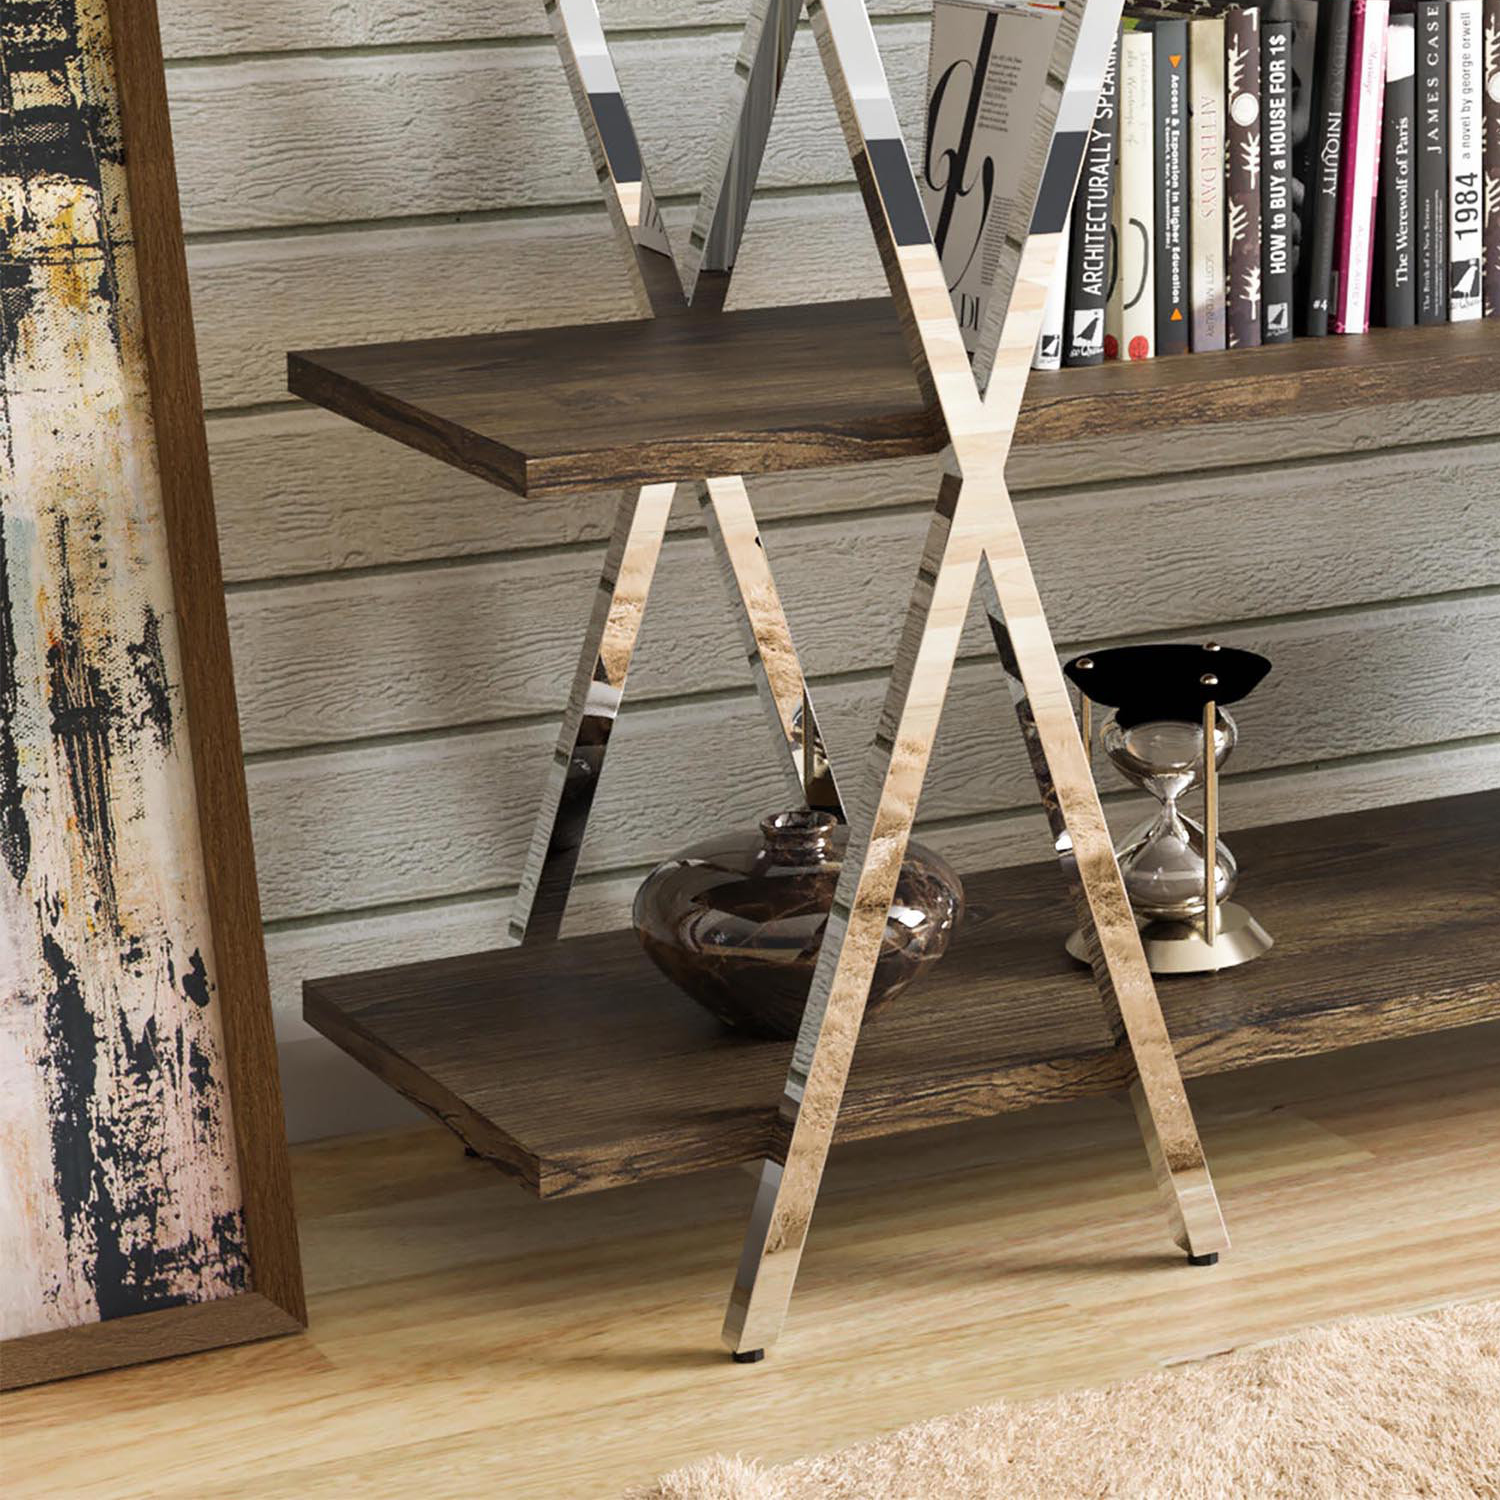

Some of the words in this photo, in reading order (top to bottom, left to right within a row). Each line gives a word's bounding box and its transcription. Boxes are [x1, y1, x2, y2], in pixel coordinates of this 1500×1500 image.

[1269, 34, 1287, 56] 1$
[1427, 6, 1439, 66] CASE
[1460, 11, 1471, 49] orwell
[1269, 59, 1287, 94] FOR
[1461, 52, 1473, 94] george
[1171, 74, 1181, 115] Access
[1461, 98, 1473, 113] by
[1171, 118, 1181, 127] &
[1200, 95, 1217, 160] AFTER
[1269, 97, 1287, 156] HOUSE
[1427, 77, 1442, 154] JAMES
[1461, 115, 1471, 148] novel
[1321, 111, 1342, 197] INIQUITY
[1395, 116, 1409, 155] Paris
[1171, 129, 1181, 189] Expansion
[1273, 159, 1286, 171] a
[1395, 156, 1408, 174] of
[1201, 168, 1217, 218] DAYS
[1270, 175, 1287, 210] BUY
[1454, 172, 1478, 240] 1984
[1082, 128, 1112, 296] ARCHITECTURALLY
[1170, 205, 1181, 244] Higher
[1271, 213, 1286, 231] to
[1395, 176, 1409, 251] Werewolf
[1423, 198, 1431, 231] Science
[1270, 233, 1287, 275] HOW
[1423, 231, 1431, 250] New
[1172, 246, 1182, 304] Education
[1395, 253, 1408, 288] The
[1423, 270, 1431, 293] Birth
[1313, 299, 1328, 311] #4
[1423, 294, 1431, 312] The
